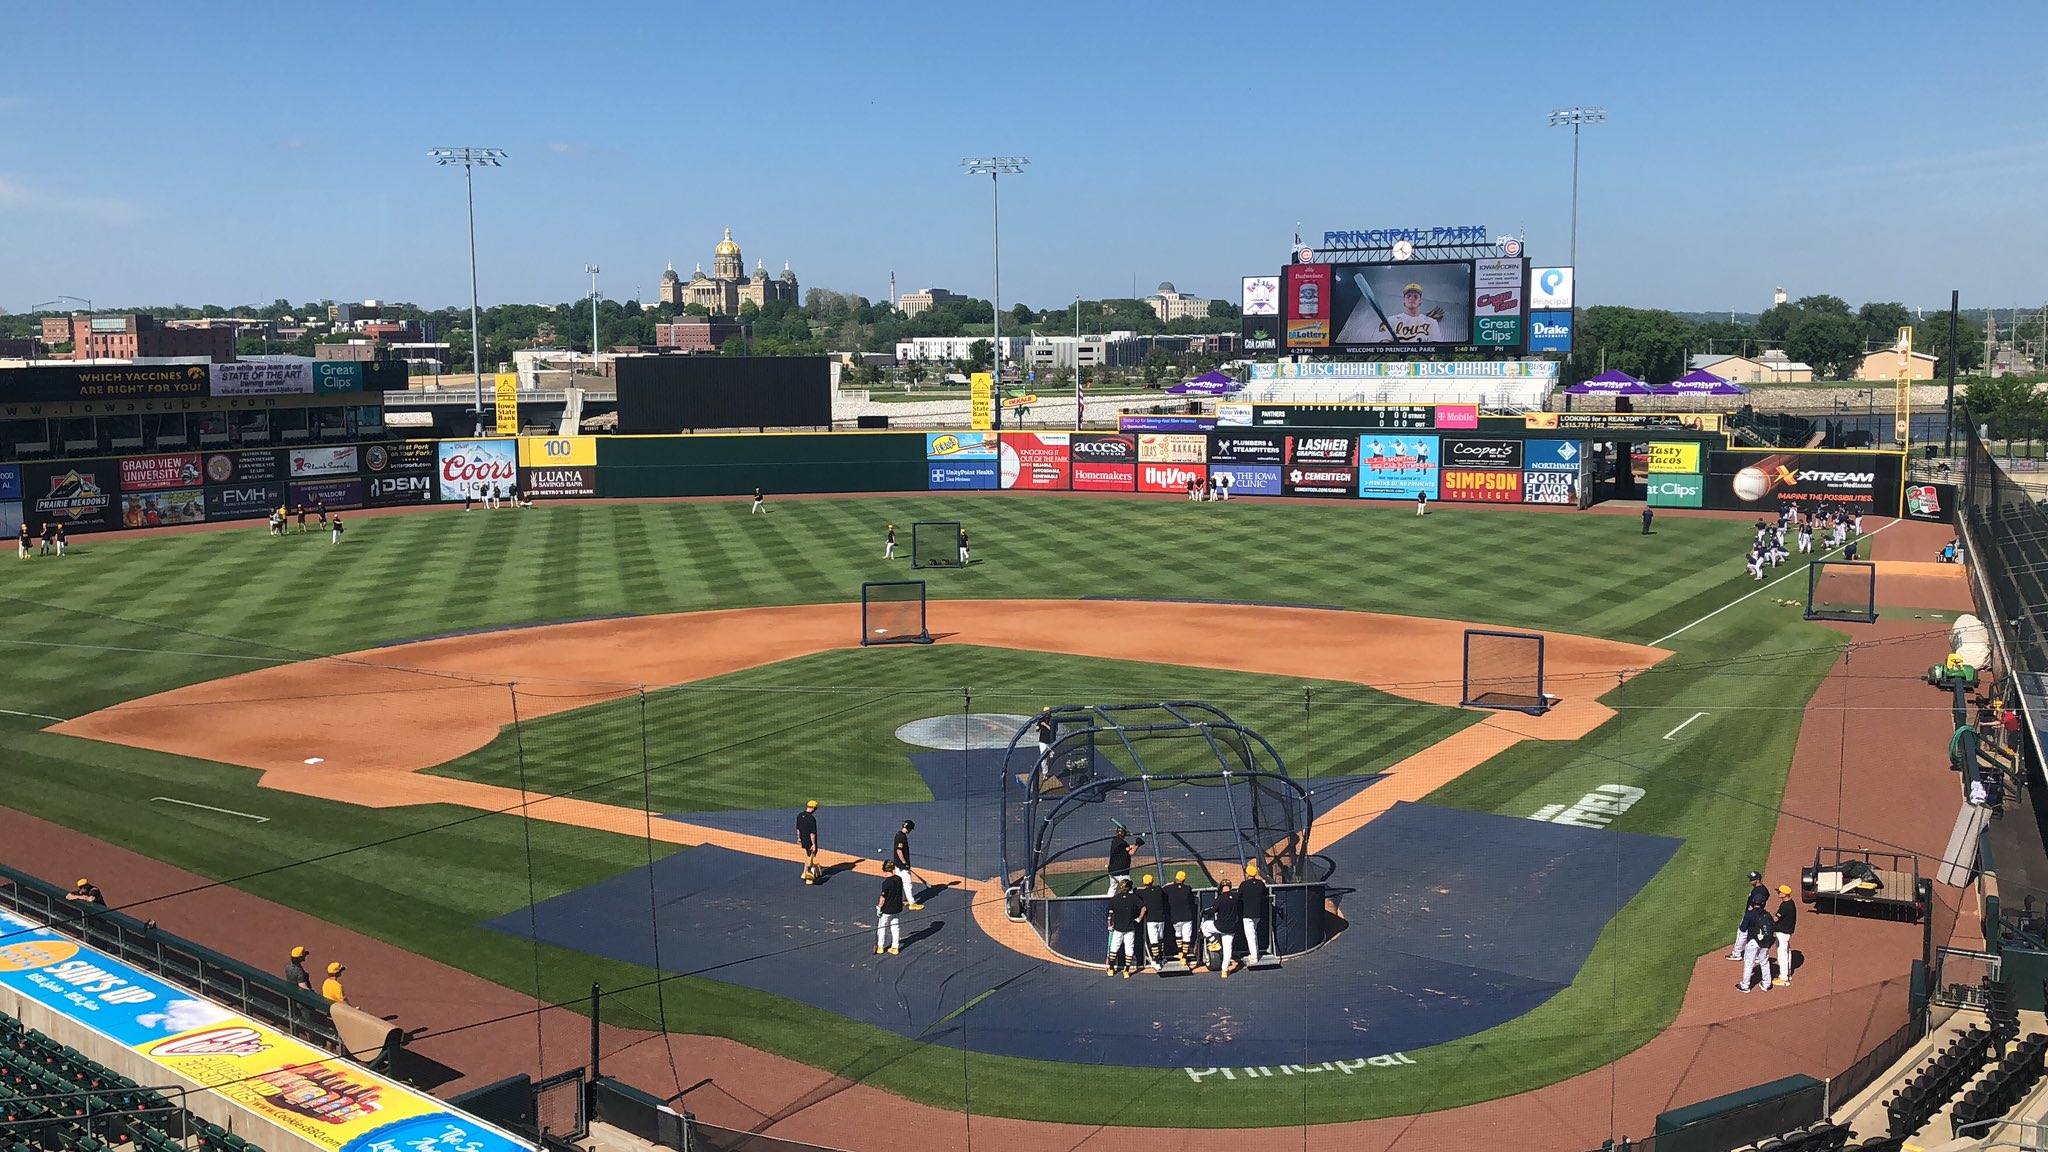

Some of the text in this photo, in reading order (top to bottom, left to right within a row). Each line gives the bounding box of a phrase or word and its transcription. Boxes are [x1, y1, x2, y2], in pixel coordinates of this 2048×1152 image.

[1324, 225, 1487, 244] PRINCIPAL PARK
[1533, 298, 1569, 306] Principal
[1479, 318, 1516, 329] Great
[1532, 322, 1569, 335] Drake
[1481, 330, 1511, 343] Clips
[219, 364, 236, 372] Earn
[320, 364, 354, 375] Great
[1300, 363, 1376, 376] BUSCHHHHH
[1386, 363, 1410, 371] BUSCH
[1419, 363, 1500, 376] BUSCHHHHH
[1529, 363, 1553, 371] BUSCH
[79, 371, 182, 382] WHICH VACCINES
[222, 370, 302, 380] STATE OF THE ART
[323, 376, 351, 389] Clips
[1583, 380, 1632, 388] Quantum
[80, 383, 201, 395] ARE RIGHT FOR YOU!
[1008, 397, 1032, 405] DEKALB
[1379, 411, 1385, 419] 0
[1447, 412, 1474, 421] Mobile
[544, 440, 571, 456] 100
[1074, 442, 1127, 453] access
[1453, 443, 1513, 458] Cooper's
[1649, 446, 1682, 457] Tasty
[122, 458, 182, 471] GRAND VIEW
[1649, 455, 1682, 464] Tacos
[442, 455, 514, 481] Coors
[123, 469, 180, 481] UNIVERSITY
[538, 471, 582, 481] LUANA
[1075, 469, 1133, 480] Homemakers
[1236, 472, 1253, 480] THE
[1304, 472, 1352, 481] CEMENTECH
[1527, 473, 1569, 483] PORK
[1797, 470, 1875, 482] XTREAM
[382, 476, 430, 492] DSM
[1445, 472, 1517, 490] SIMPSON
[223, 487, 266, 503] FMH
[1452, 491, 1509, 499] COLLEGE
[1525, 484, 1569, 495] FLAVOR
[1660, 483, 1696, 498] Clips
[39, 497, 106, 509] PRAIRIE MEADOWS
[1525, 493, 1569, 503] FLAVOR
[43, 960, 129, 993] SUN'S
[97, 985, 157, 1005] UP
